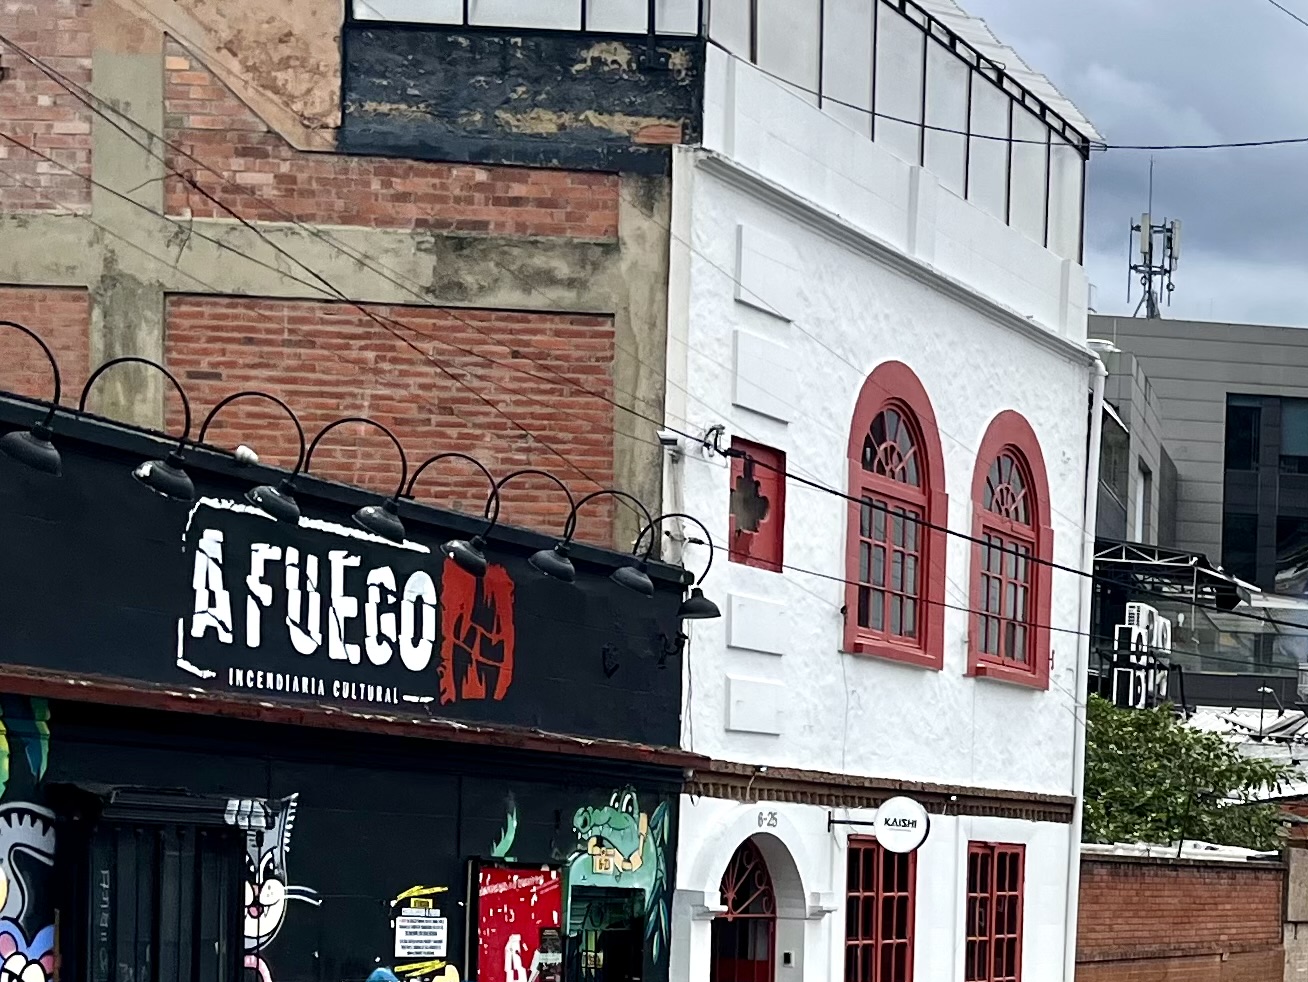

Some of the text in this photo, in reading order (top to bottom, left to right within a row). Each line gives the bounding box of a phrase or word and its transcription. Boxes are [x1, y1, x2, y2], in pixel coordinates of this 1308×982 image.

[191, 528, 437, 672] A FUEGO
[228, 667, 399, 704] INCENDIARIA CULTURAL
[757, 811, 778, 828] 6-25
[883, 817, 917, 829] KAISHI
